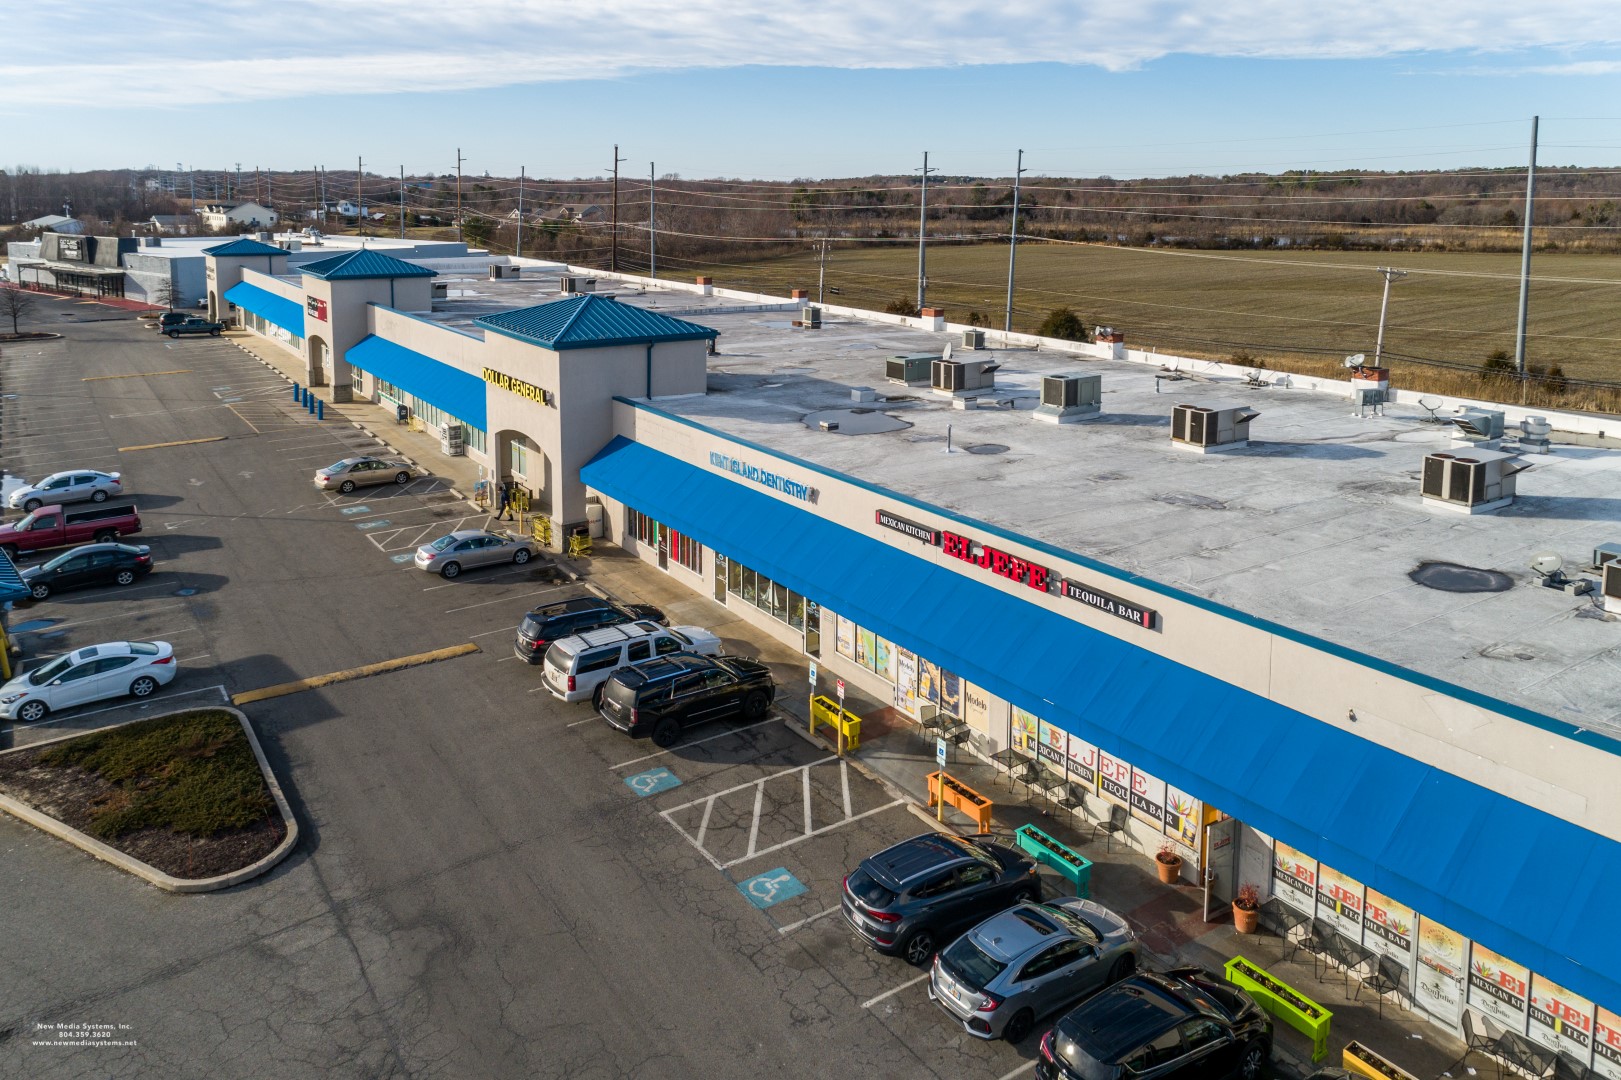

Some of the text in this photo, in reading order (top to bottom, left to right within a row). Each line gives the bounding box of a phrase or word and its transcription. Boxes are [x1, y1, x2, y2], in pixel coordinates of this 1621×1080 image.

[482, 367, 546, 406] DOLLAR GENERAL
[709, 451, 807, 502] KENT ISLAND DENTISTRY
[880, 514, 931, 541] MEXICAN KITCHEN
[943, 530, 1050, 593] EL JEFE
[1069, 585, 1141, 623] TEQUILA BAR
[966, 692, 987, 711] Modelo
[1049, 728, 1147, 796] EL JEFE
[1103, 777, 1147, 809] TEQUILA
[1150, 804, 1174, 825] BAR
[1275, 869, 1303, 890] MEXICAN
[1388, 932, 1407, 948] BAR
[1472, 975, 1509, 1001] MEXICAN
